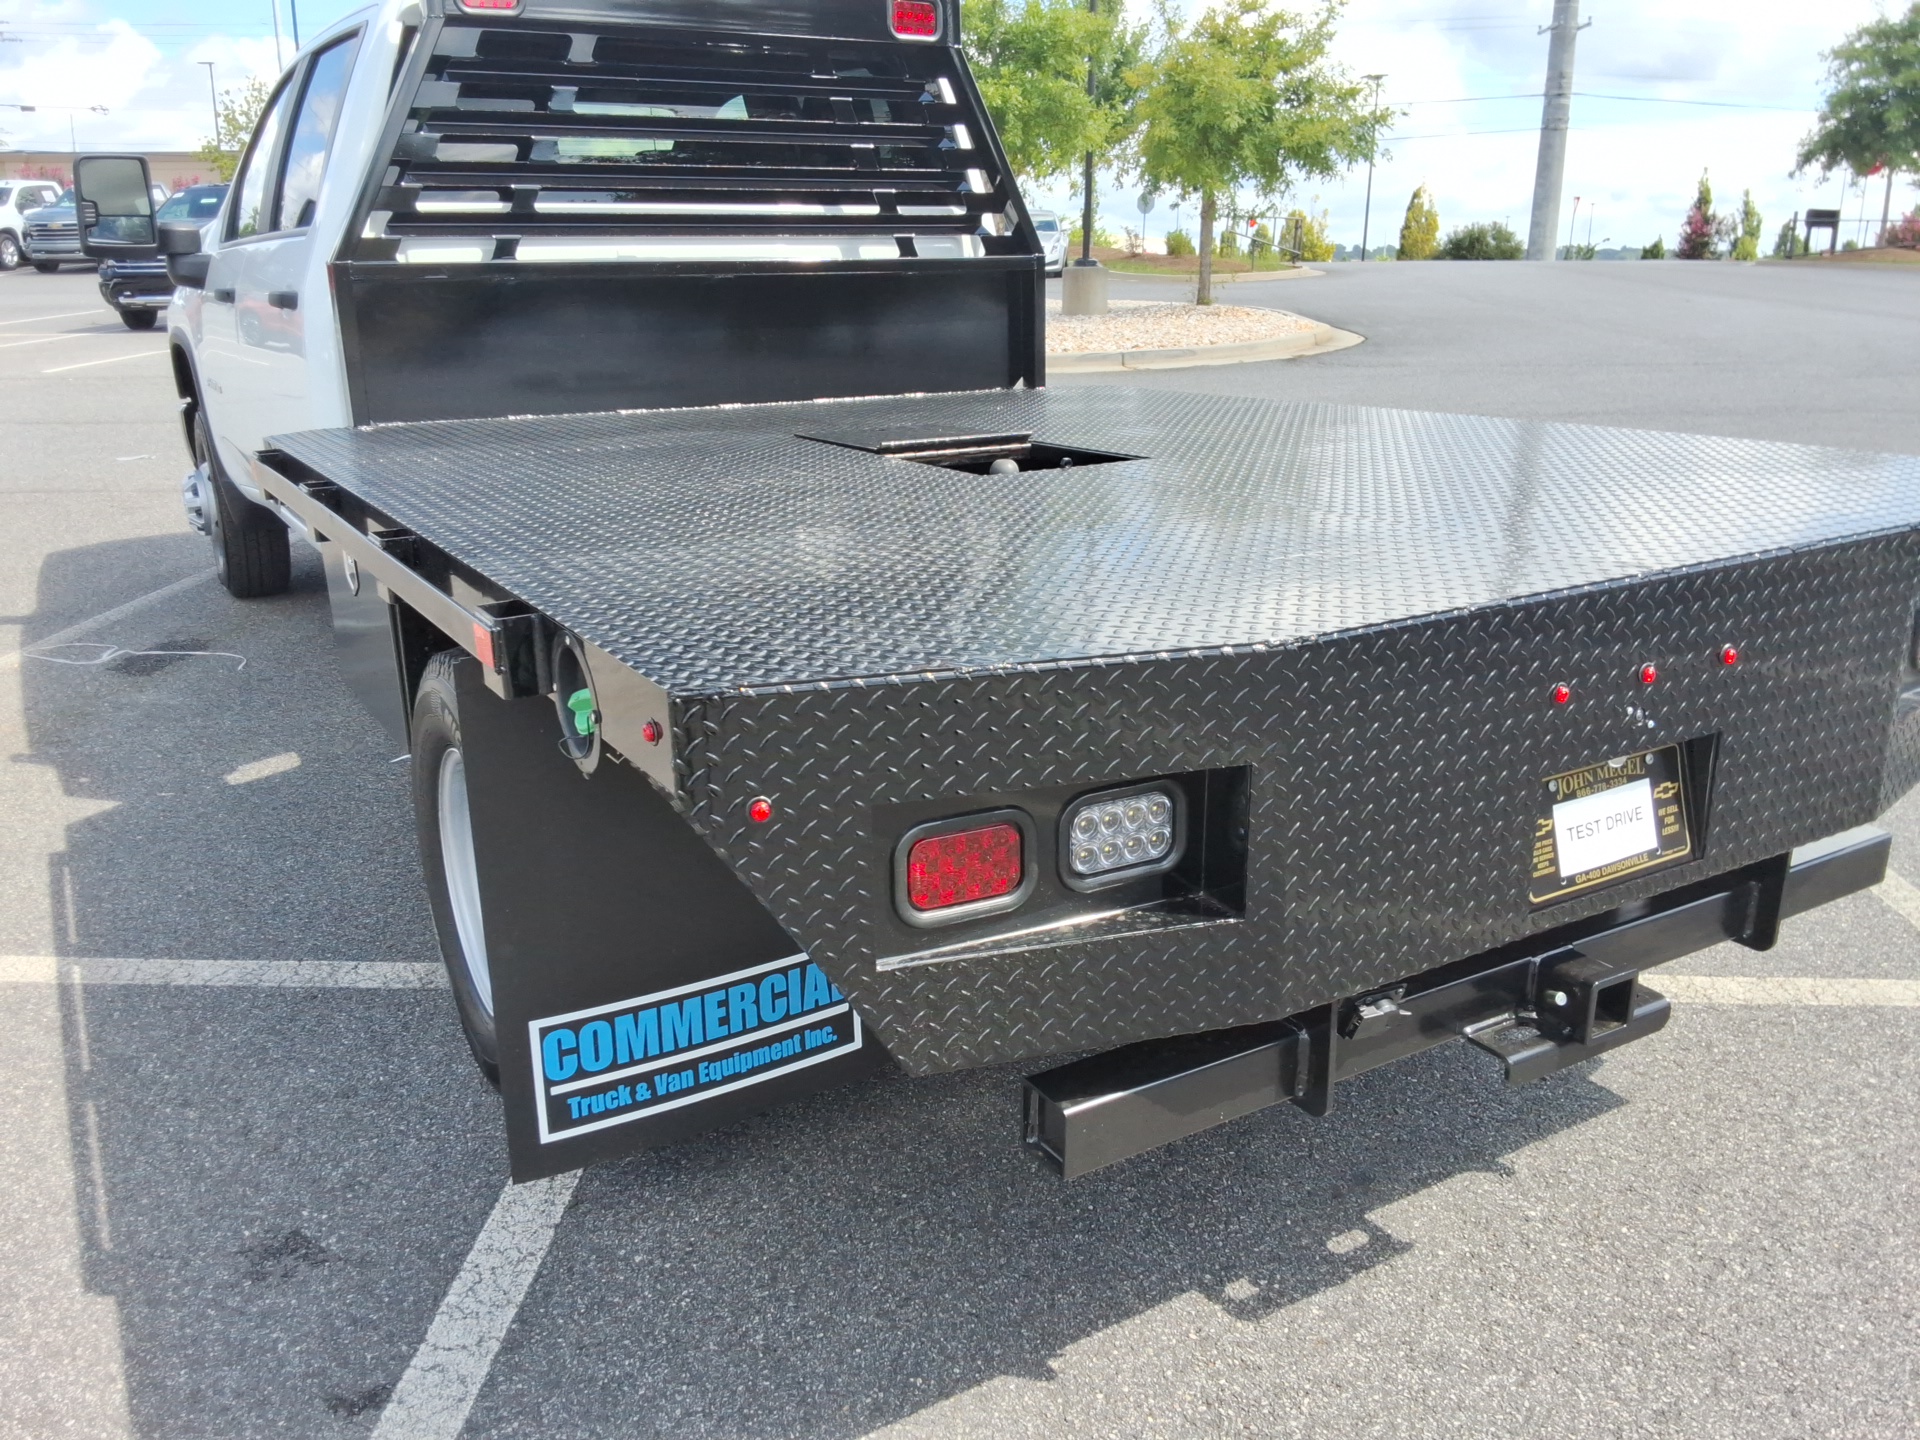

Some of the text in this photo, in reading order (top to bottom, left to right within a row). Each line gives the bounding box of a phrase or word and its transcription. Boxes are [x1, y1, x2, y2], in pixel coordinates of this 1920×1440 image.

[1557, 757, 1645, 800] JOHN MEGEL
[1567, 806, 1643, 841] TEST DRIVE
[1602, 853, 1649, 875] DAWSONVILLE
[542, 963, 847, 1081] COMMERCIA
[567, 1023, 838, 1119] Truck & Van Equipment Inc.
